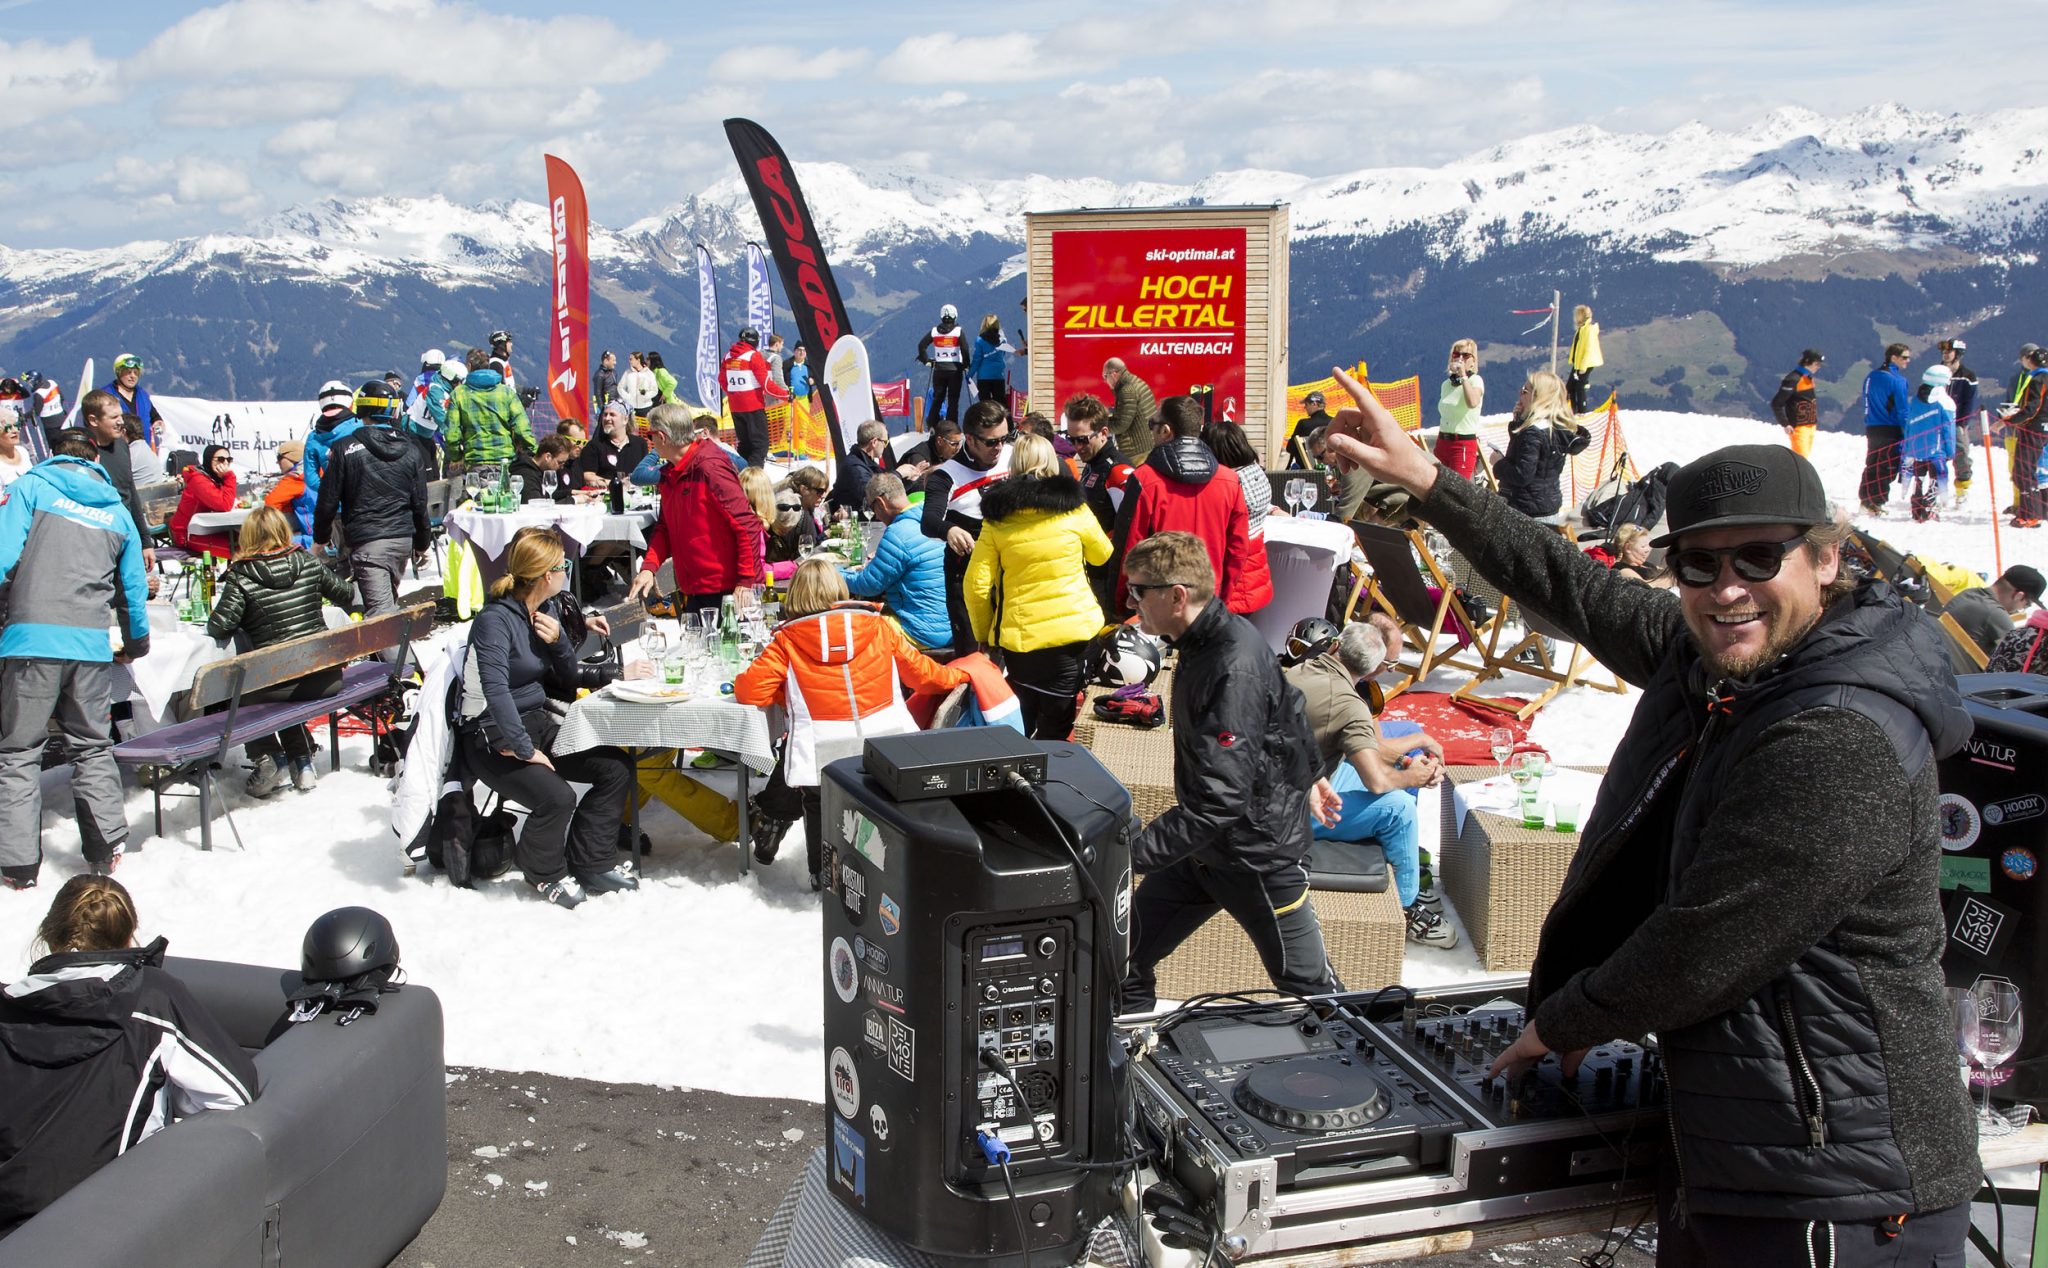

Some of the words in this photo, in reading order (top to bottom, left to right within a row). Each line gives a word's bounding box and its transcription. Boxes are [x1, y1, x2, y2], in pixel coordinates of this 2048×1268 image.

[1145, 248, 1235, 262] ski-optimal.at
[1140, 275, 1232, 299] HOCH
[1064, 304, 1235, 328] ZILLERTAL
[1140, 342, 1232, 355] KALTENBACH
[729, 377, 746, 386] 40
[223, 440, 249, 450] DER
[1730, 468, 1761, 489] WALL
[51, 498, 115, 526] AUSTRIA
[1988, 743, 2016, 763] TUR
[2003, 796, 2038, 814] HOODY
[866, 945, 887, 965] HOODY
[886, 983, 904, 1004] TUR
[865, 1018, 884, 1043] IBIZA
[835, 1071, 853, 1096] Tirol
[1325, 1126, 1378, 1138] Pioneer
